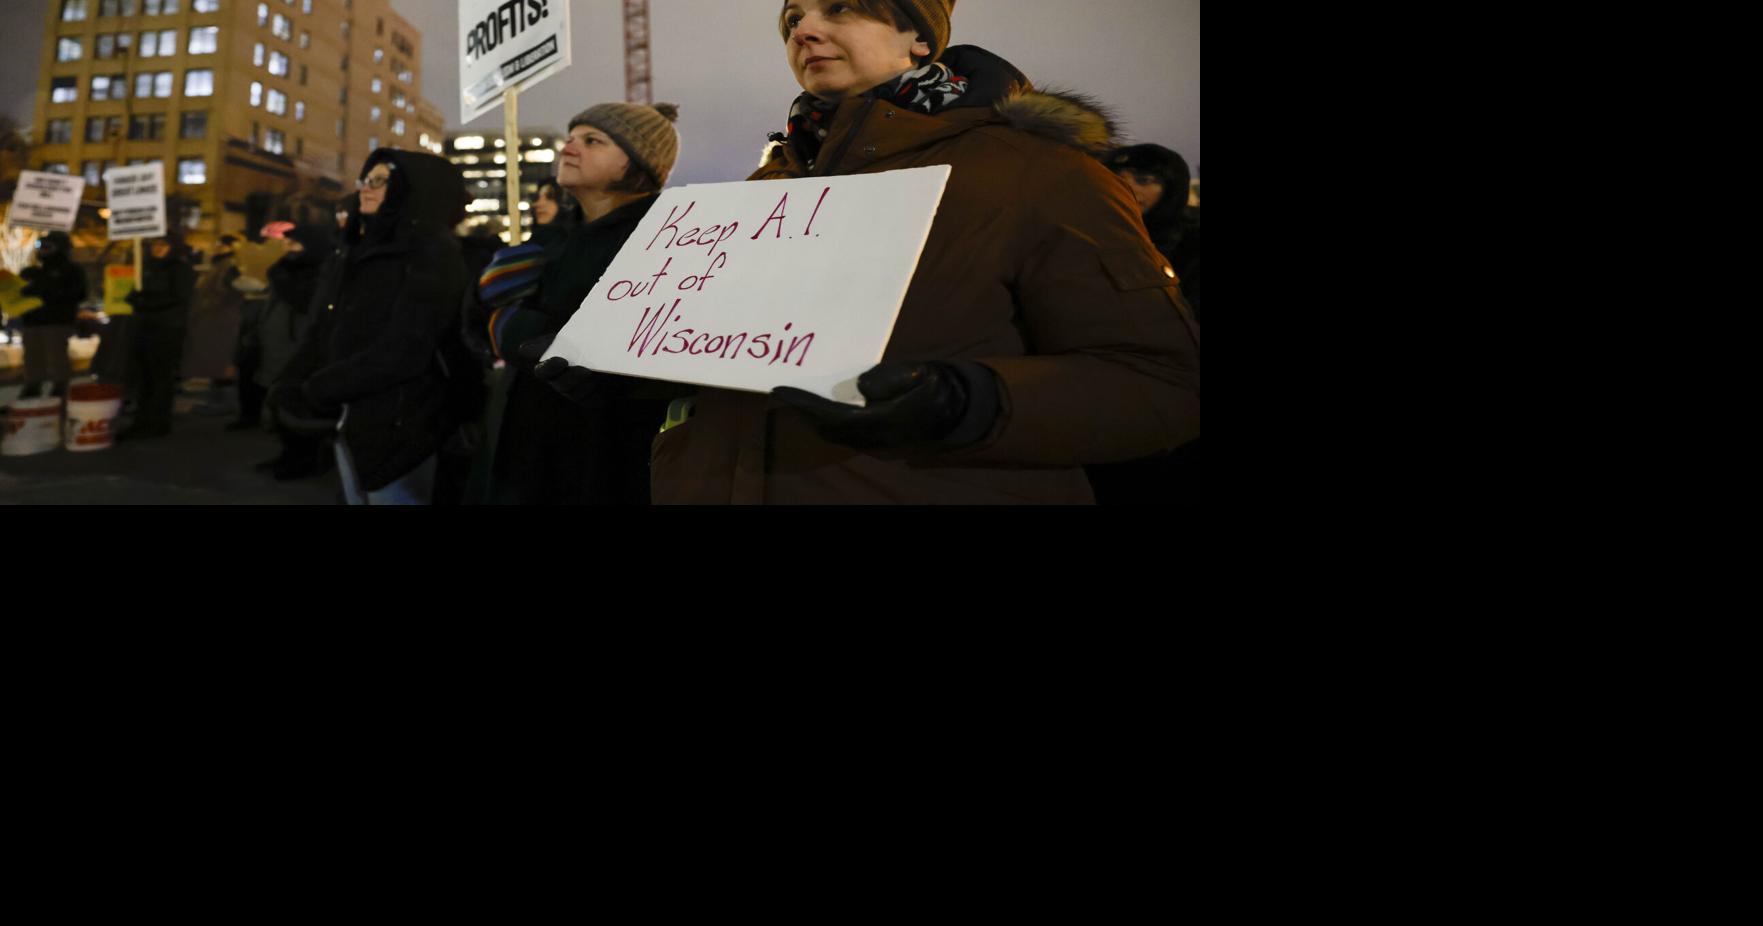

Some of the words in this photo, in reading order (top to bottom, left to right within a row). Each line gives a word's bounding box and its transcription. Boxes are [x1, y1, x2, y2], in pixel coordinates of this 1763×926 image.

[646, 201, 739, 256] Keep
[750, 186, 831, 241] A.I.
[606, 256, 672, 301] out
[678, 252, 727, 291] of
[627, 298, 815, 366] Wisconsin
